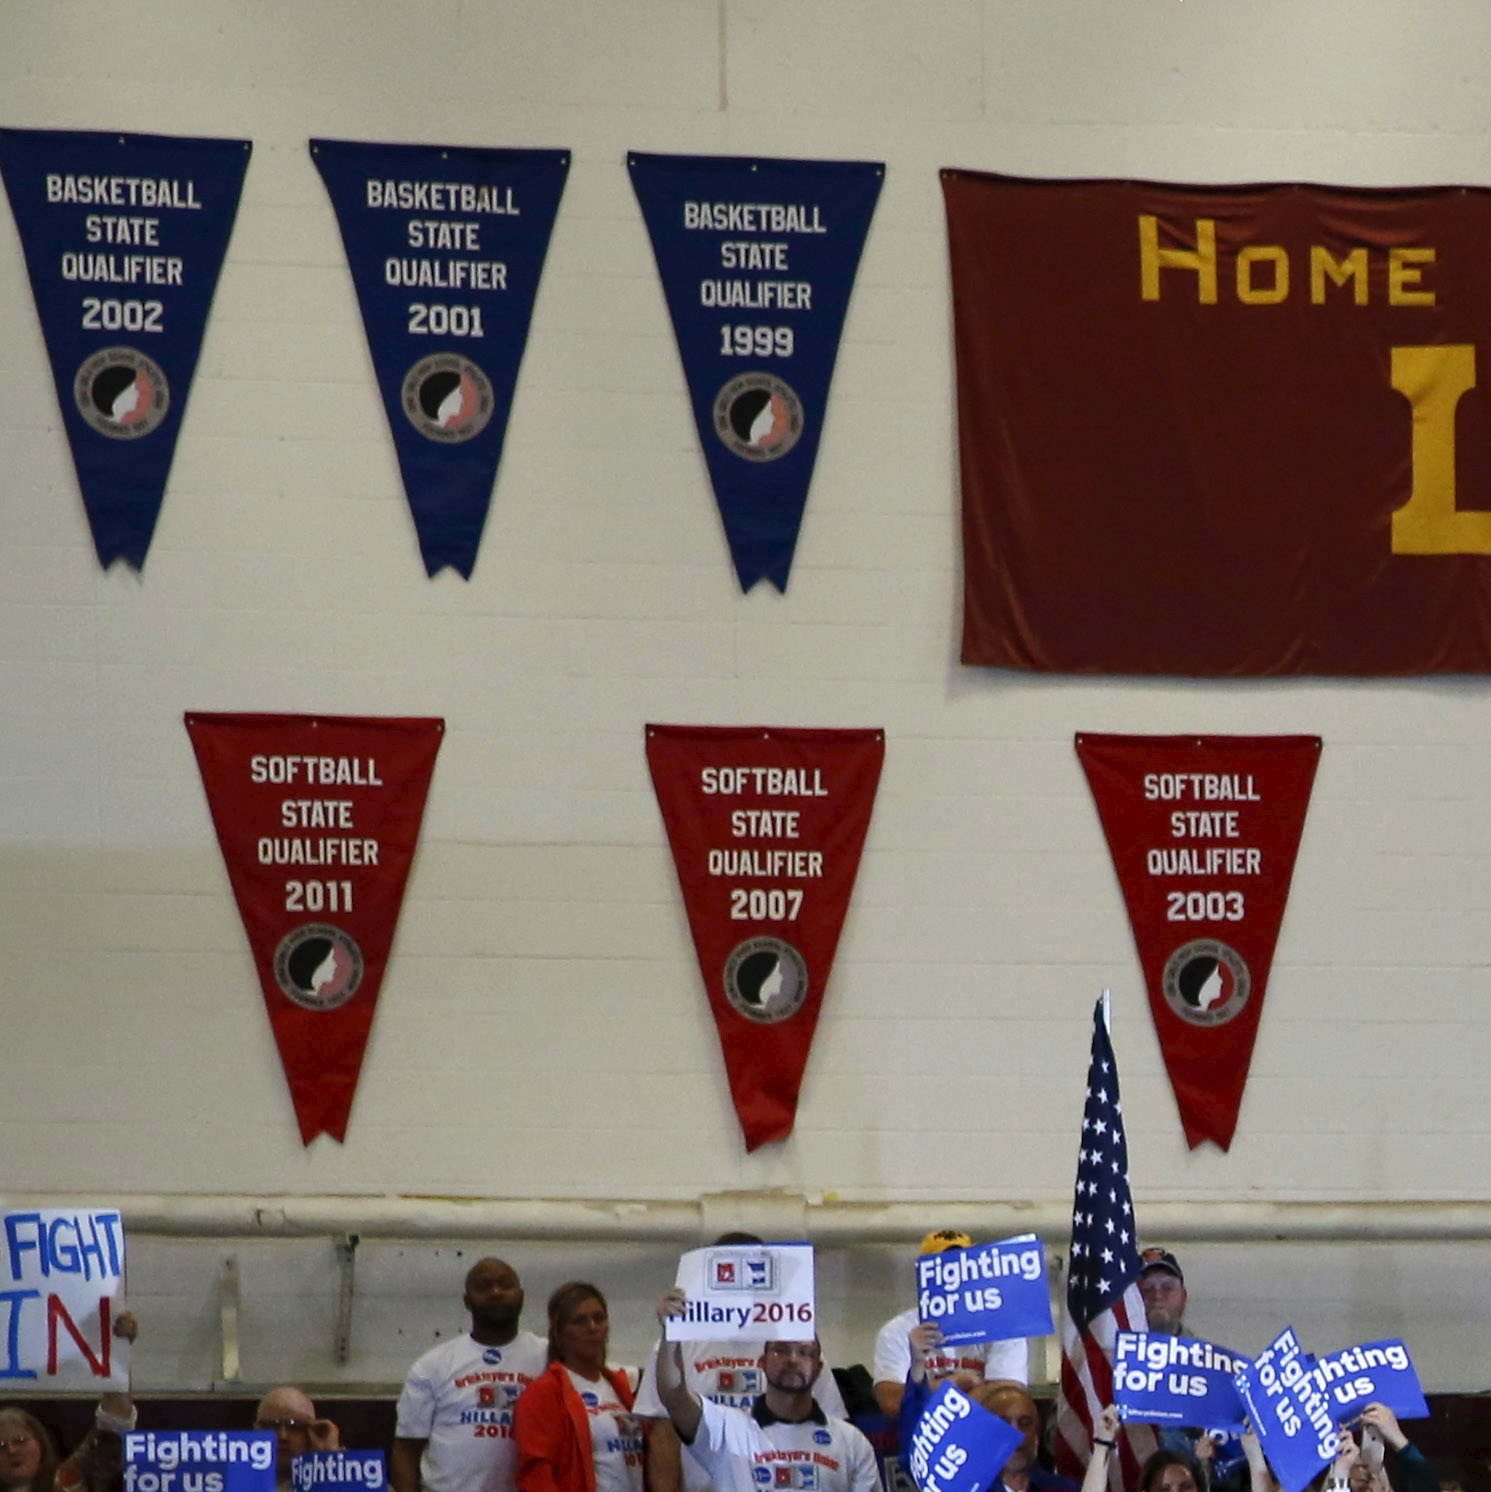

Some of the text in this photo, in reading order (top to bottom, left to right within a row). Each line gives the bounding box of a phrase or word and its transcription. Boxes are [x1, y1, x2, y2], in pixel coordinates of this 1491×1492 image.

[47, 175, 201, 209] BASKETBALL
[368, 181, 519, 214] BASKETBALL
[86, 216, 159, 246] STATE
[685, 202, 826, 233] BASKETBALL
[409, 221, 479, 250] STATE
[62, 254, 182, 285] QUALIFIER
[721, 242, 788, 270] STATE
[386, 258, 506, 289] QUALIFIER
[701, 281, 811, 309] QUALIFIER
[83, 299, 163, 332] 2002
[409, 304, 483, 337] 2001
[721, 326, 793, 356] 1999
[251, 756, 382, 785] SOFTBALL
[702, 768, 828, 796] SOFTBALL
[1145, 774, 1260, 800] SOFTBALL
[282, 800, 353, 828] STATE
[732, 811, 799, 837] STATE
[1171, 811, 1239, 837] STATE
[258, 838, 378, 865] QUALIFIER
[709, 850, 822, 877] QUALIFIER
[1148, 848, 1260, 875] QUALIFIER
[286, 881, 352, 911] 2011
[731, 890, 803, 920] 2007
[1167, 891, 1244, 920] 2003
[4, 1213, 121, 1282] FIGHT
[921, 1248, 1041, 1290] Fighting
[920, 1288, 1001, 1319] for us
[0, 1290, 111, 1378] IN
[126, 1433, 271, 1469] Fighting
[124, 1465, 223, 1492] for us
